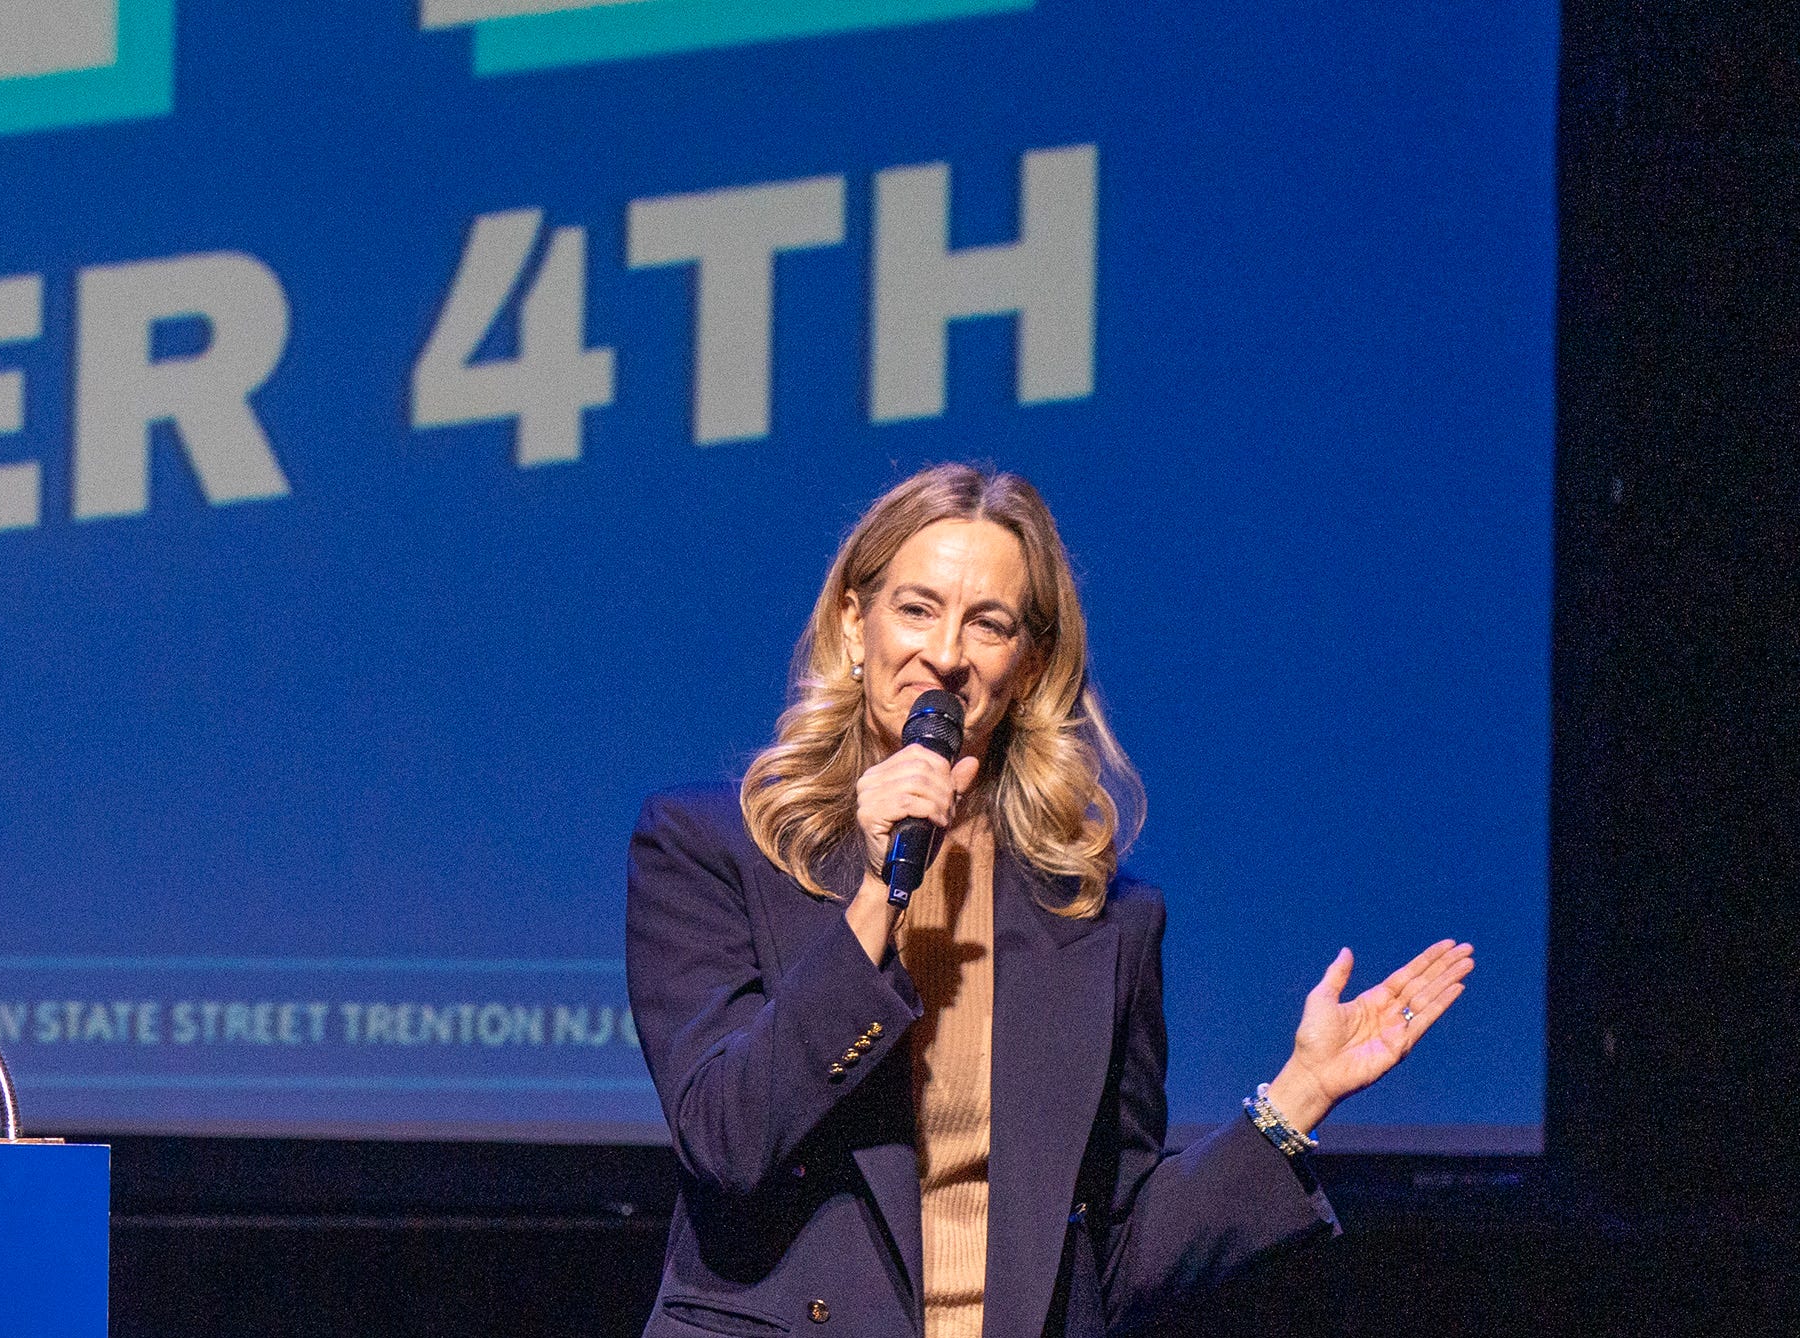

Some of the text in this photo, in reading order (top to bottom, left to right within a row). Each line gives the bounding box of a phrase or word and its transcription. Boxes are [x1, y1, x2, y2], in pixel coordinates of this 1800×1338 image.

[410, 144, 1098, 469] 4TH
[36, 999, 161, 1041] STATE
[171, 1000, 328, 1042] STREET
[339, 1001, 544, 1044] TRENTON
[552, 1002, 615, 1044] NJ
